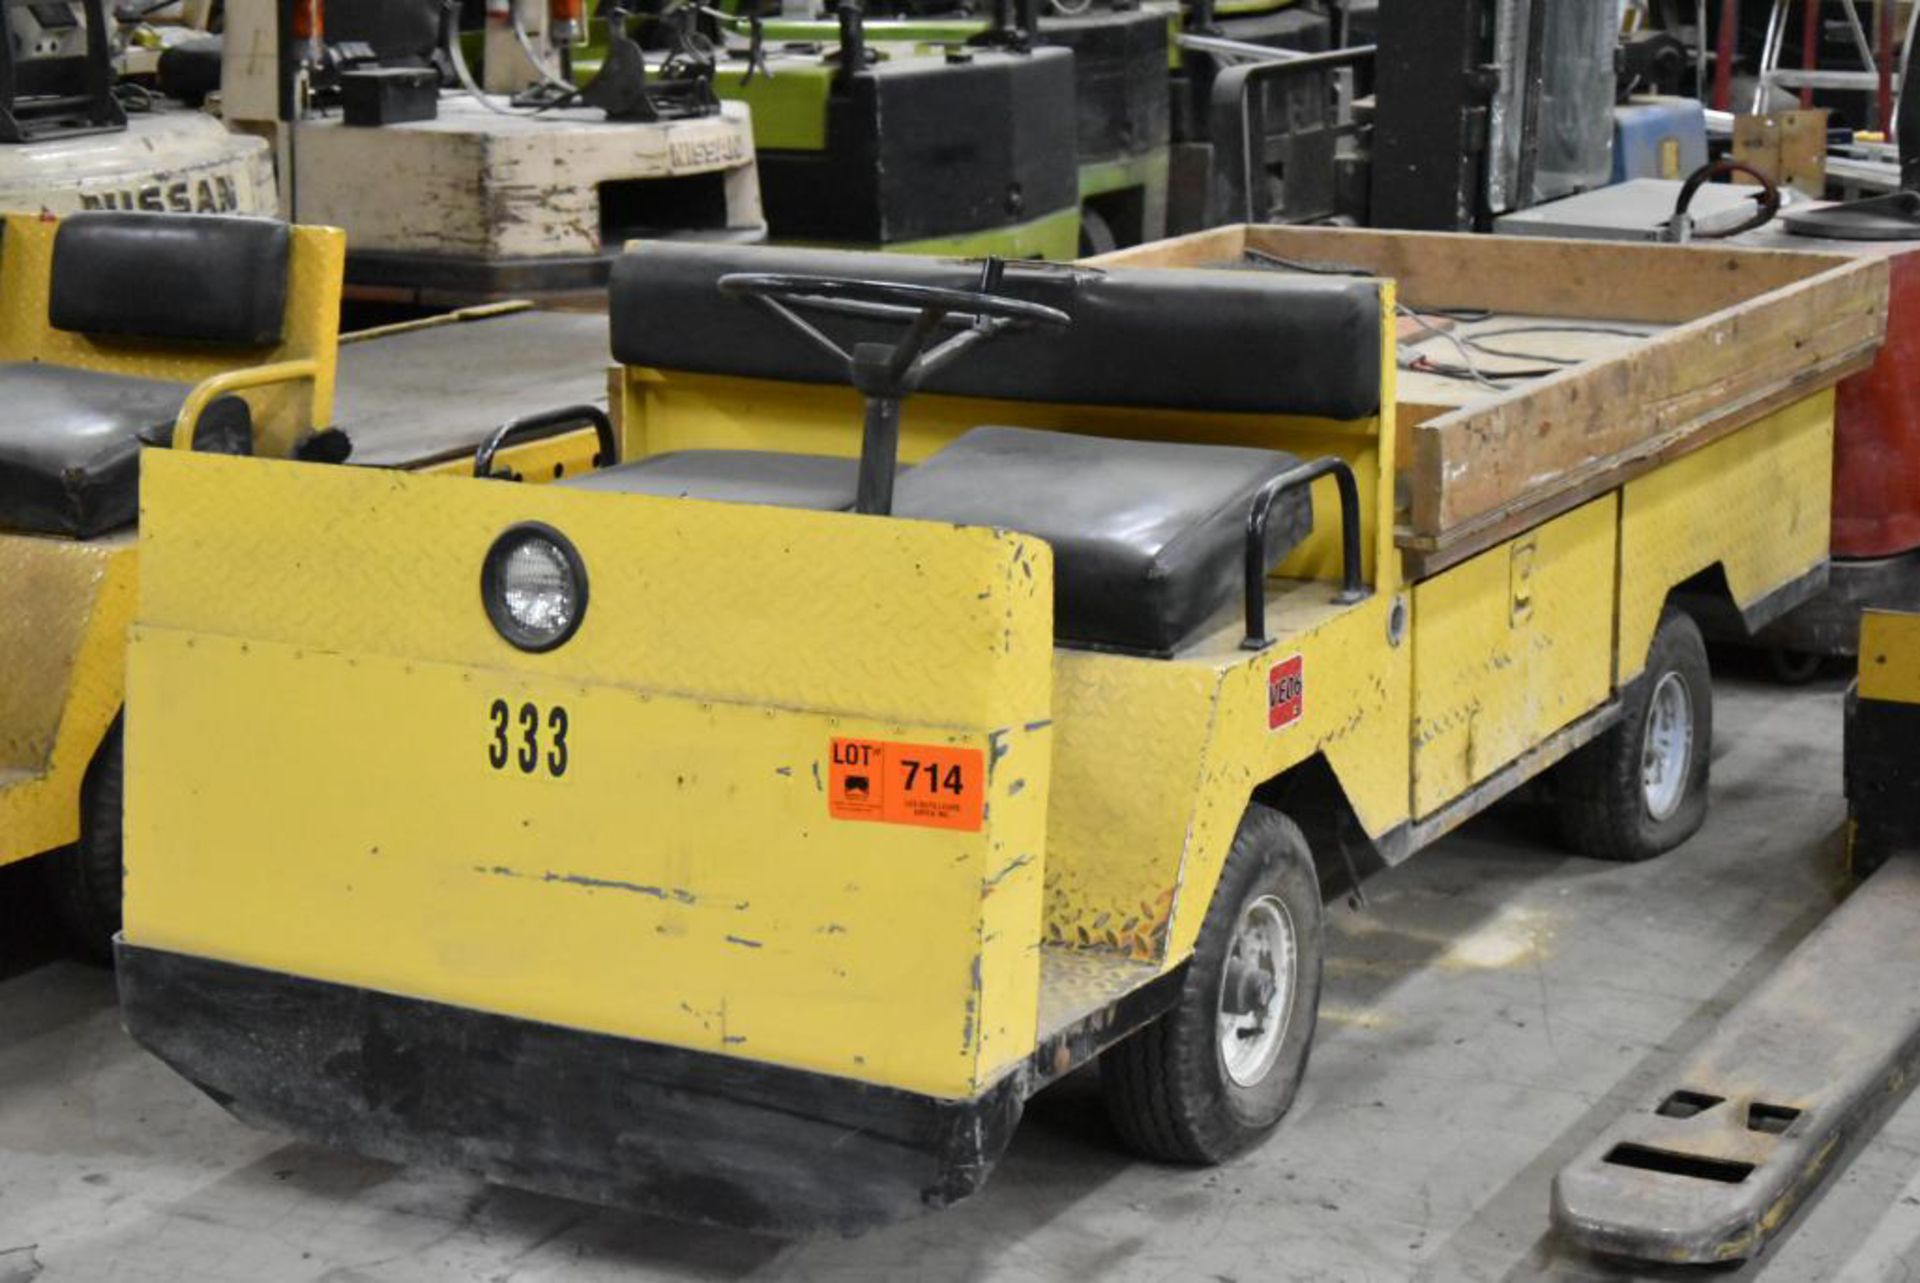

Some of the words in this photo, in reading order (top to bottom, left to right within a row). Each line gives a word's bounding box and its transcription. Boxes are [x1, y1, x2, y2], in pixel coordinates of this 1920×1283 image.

[489, 698, 568, 778] 333
[833, 743, 872, 766] LOT
[901, 760, 964, 795] 714
